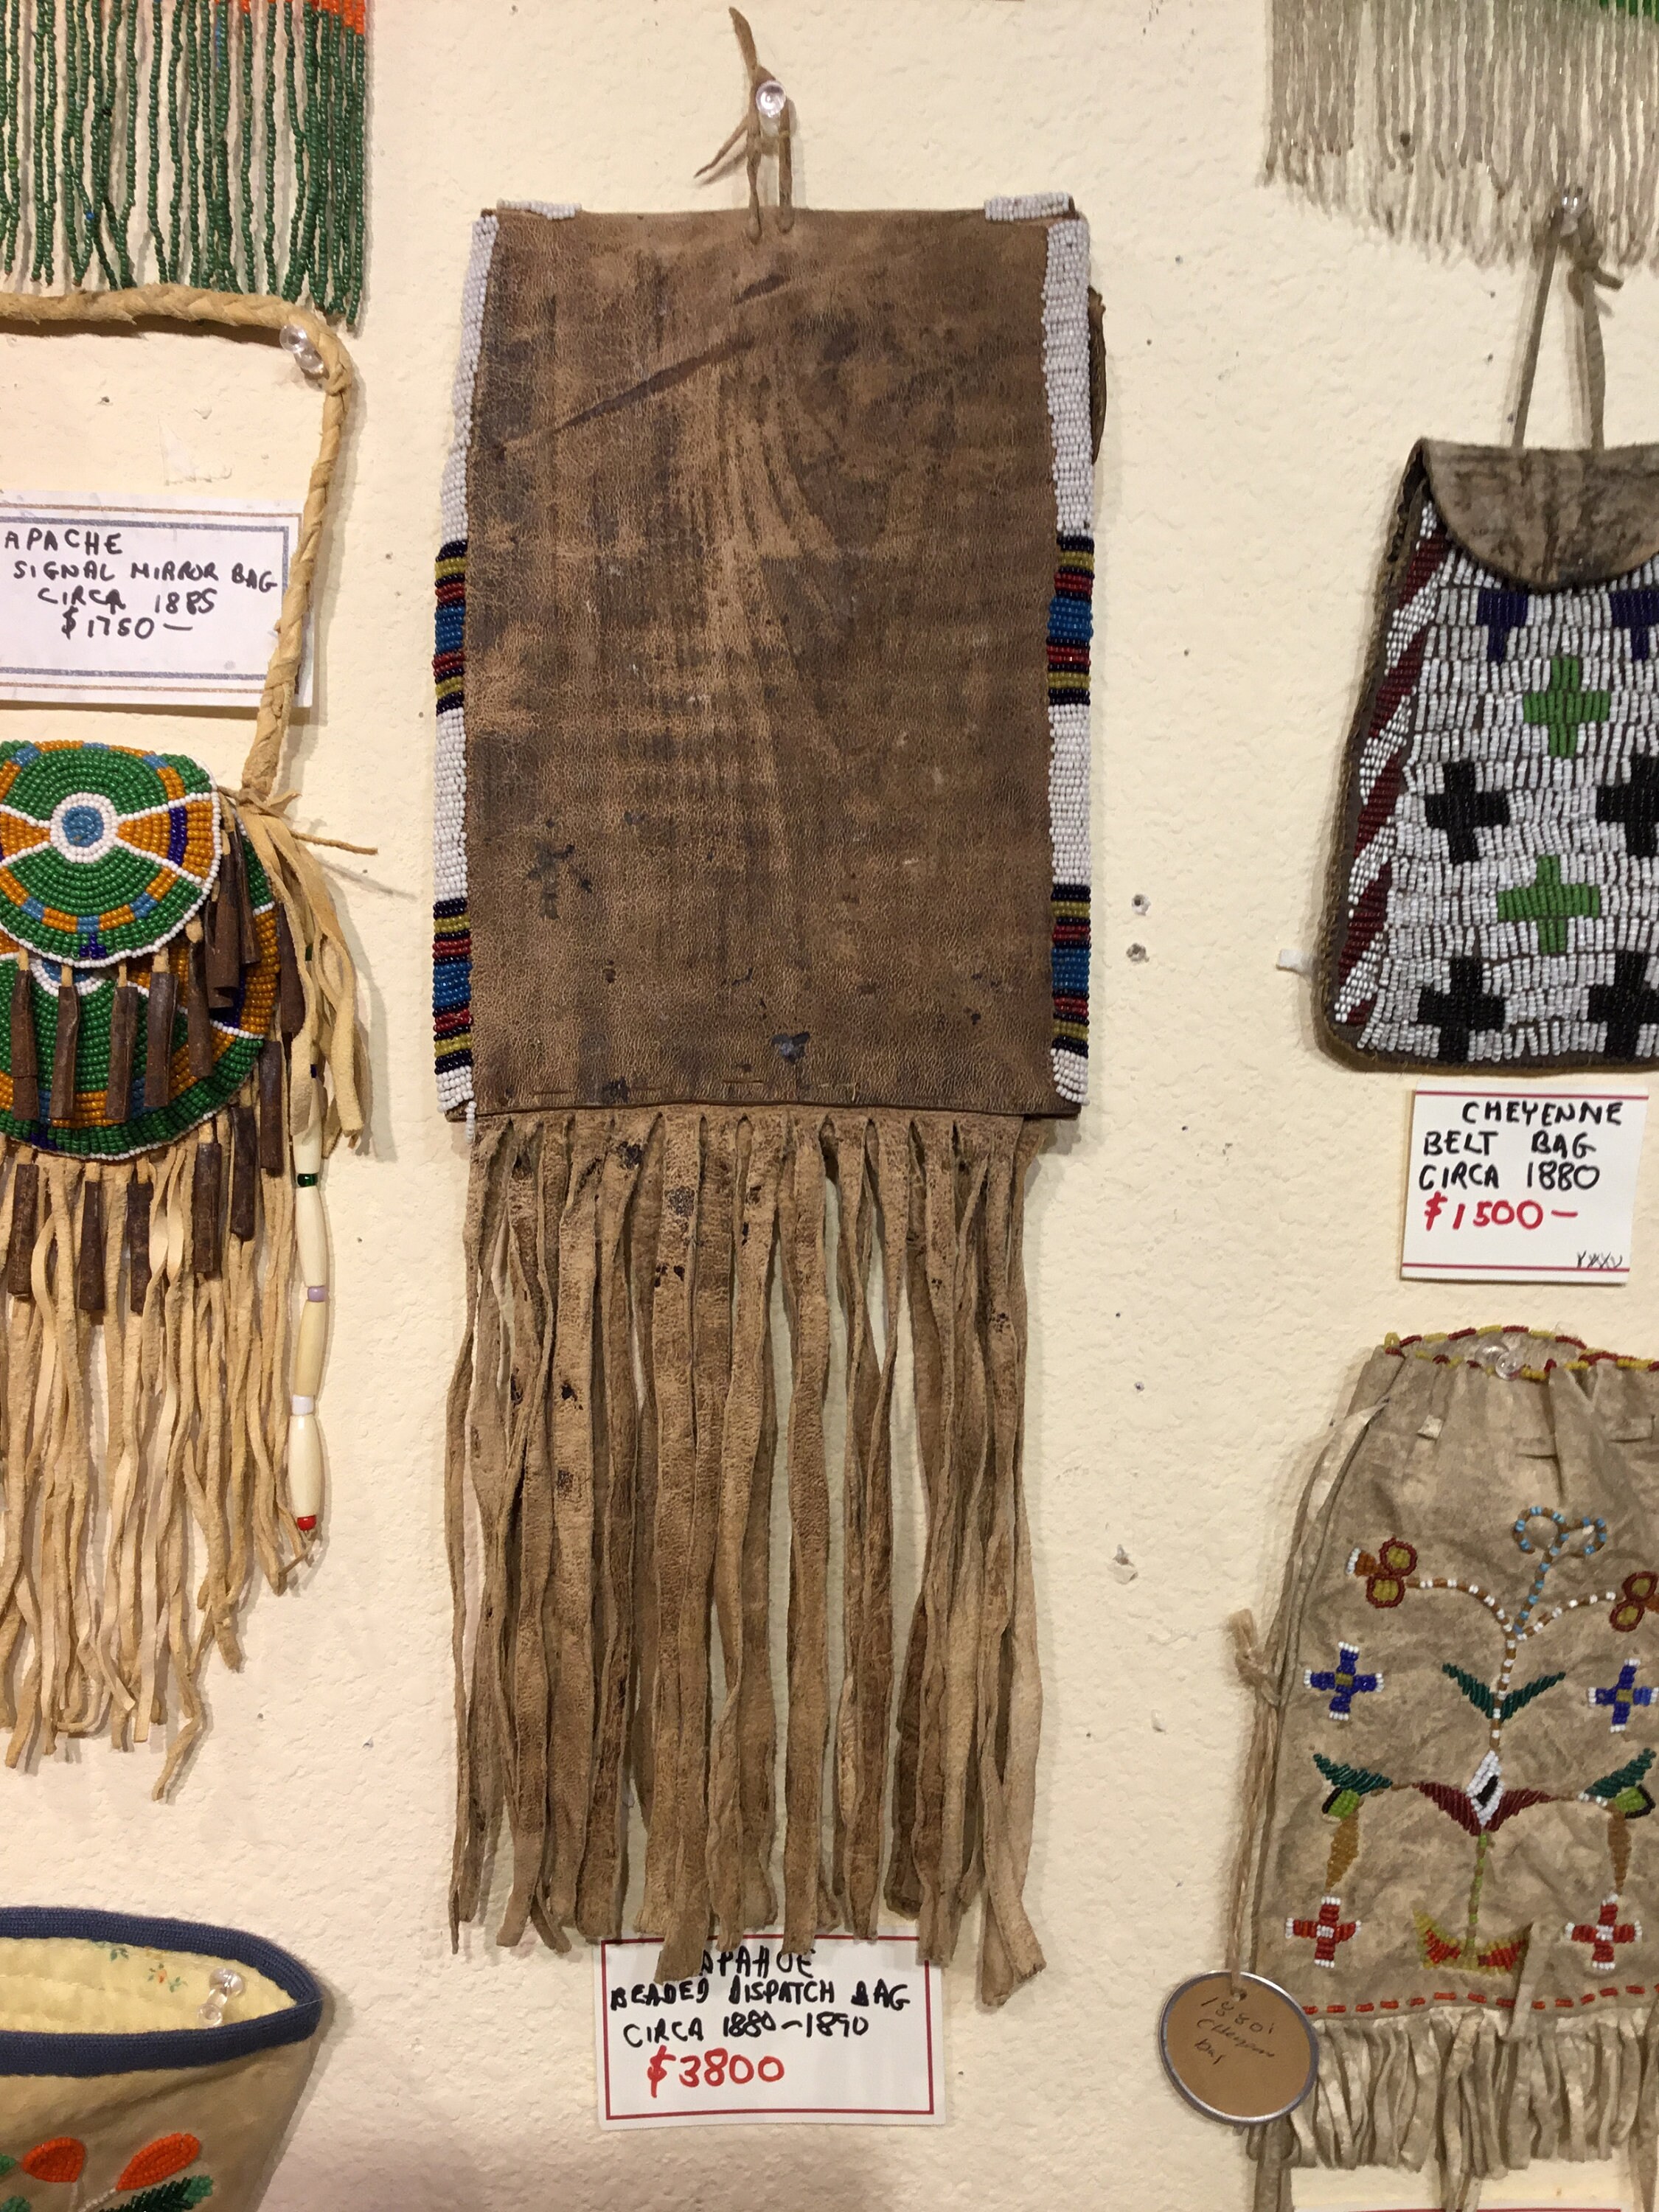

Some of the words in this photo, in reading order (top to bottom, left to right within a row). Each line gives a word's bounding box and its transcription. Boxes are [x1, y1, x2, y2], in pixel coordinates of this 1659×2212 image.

[4, 526, 122, 555] APACHE
[13, 560, 115, 581] SIGNAL
[131, 560, 218, 581] MIRROR
[232, 563, 277, 593] BAG
[38, 585, 126, 613] CIRCA
[155, 588, 218, 615] 1885
[1462, 1101, 1623, 1127] CHEYENNE
[1424, 1130, 1498, 1156] BELT
[1531, 1130, 1596, 1159] BAG
[1419, 1161, 1499, 1191] CIRCA
[1528, 1161, 1599, 1191] 1880
[700, 1945, 816, 1978] APAHOE
[611, 1982, 709, 2011] BEADED
[728, 1975, 835, 2005] DISPATCH
[851, 1979, 911, 2011] BAG
[623, 2017, 704, 2048] CIRCA
[647, 2045, 785, 2098] $3800
